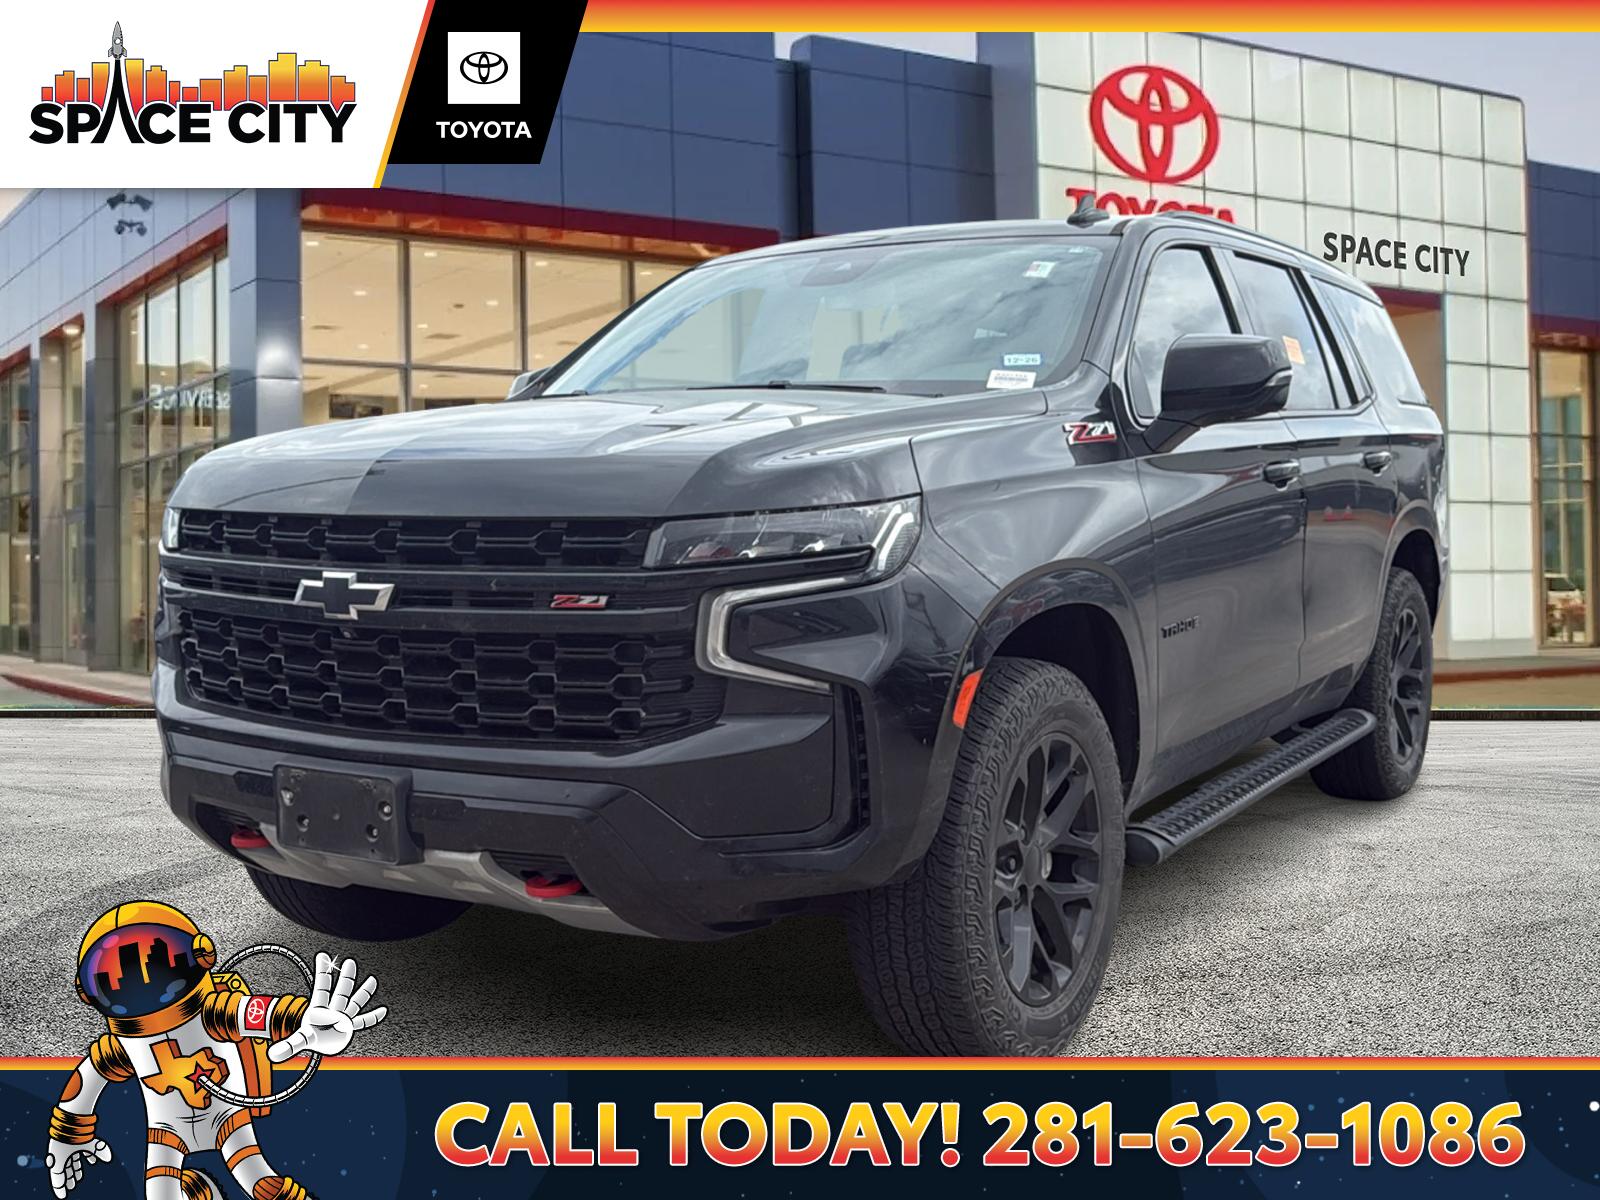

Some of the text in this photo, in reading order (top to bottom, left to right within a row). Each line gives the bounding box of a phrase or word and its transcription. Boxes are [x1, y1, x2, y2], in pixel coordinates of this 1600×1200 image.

[1066, 187, 1234, 224] TOY
[1323, 231, 1470, 277] SPACE CITY
[1063, 420, 1117, 445] Z71
[550, 594, 609, 609] Z71
